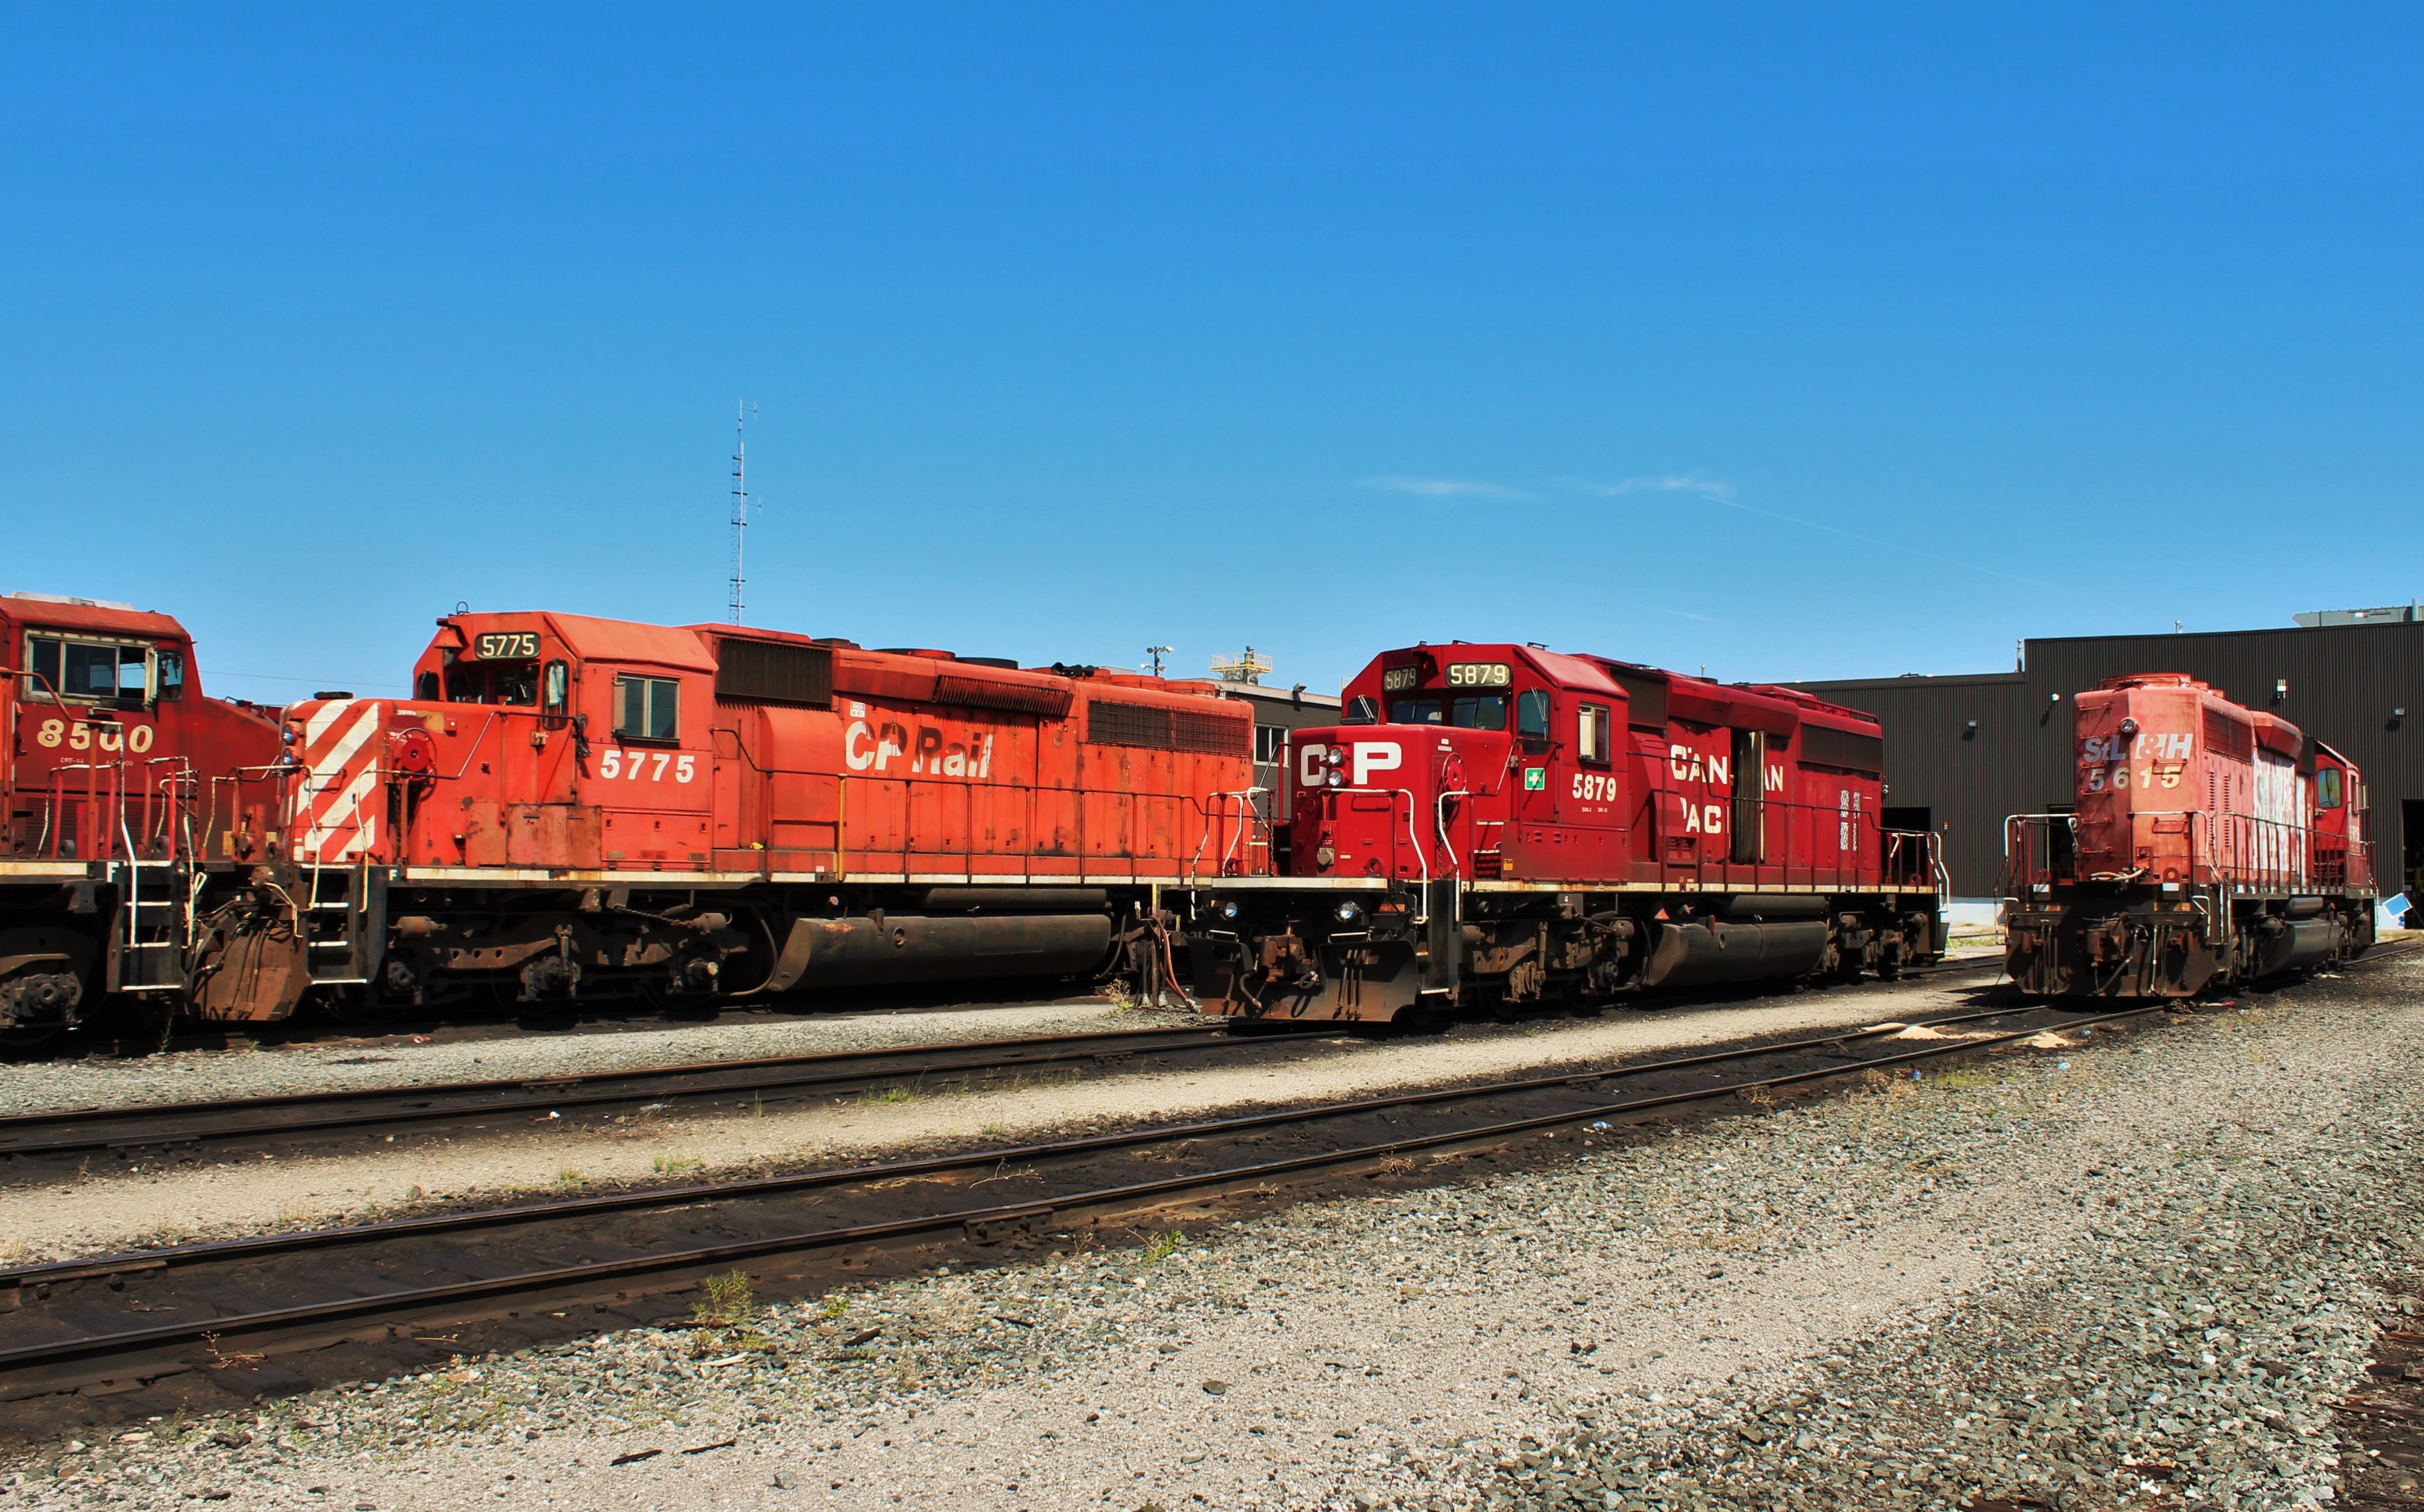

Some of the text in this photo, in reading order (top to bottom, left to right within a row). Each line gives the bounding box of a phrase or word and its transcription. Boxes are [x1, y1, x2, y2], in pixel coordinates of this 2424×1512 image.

[482, 634, 534, 656] 5775
[1386, 668, 1415, 689] 5879
[1450, 665, 1505, 684] 5879
[37, 719, 153, 753] 8500
[845, 721, 993, 778] CP Rail
[601, 750, 695, 783] 5775
[2089, 765, 2181, 791] 5615
[1572, 773, 1616, 802] 5879
[107, 862, 120, 882] F
[389, 869, 397, 881] F
